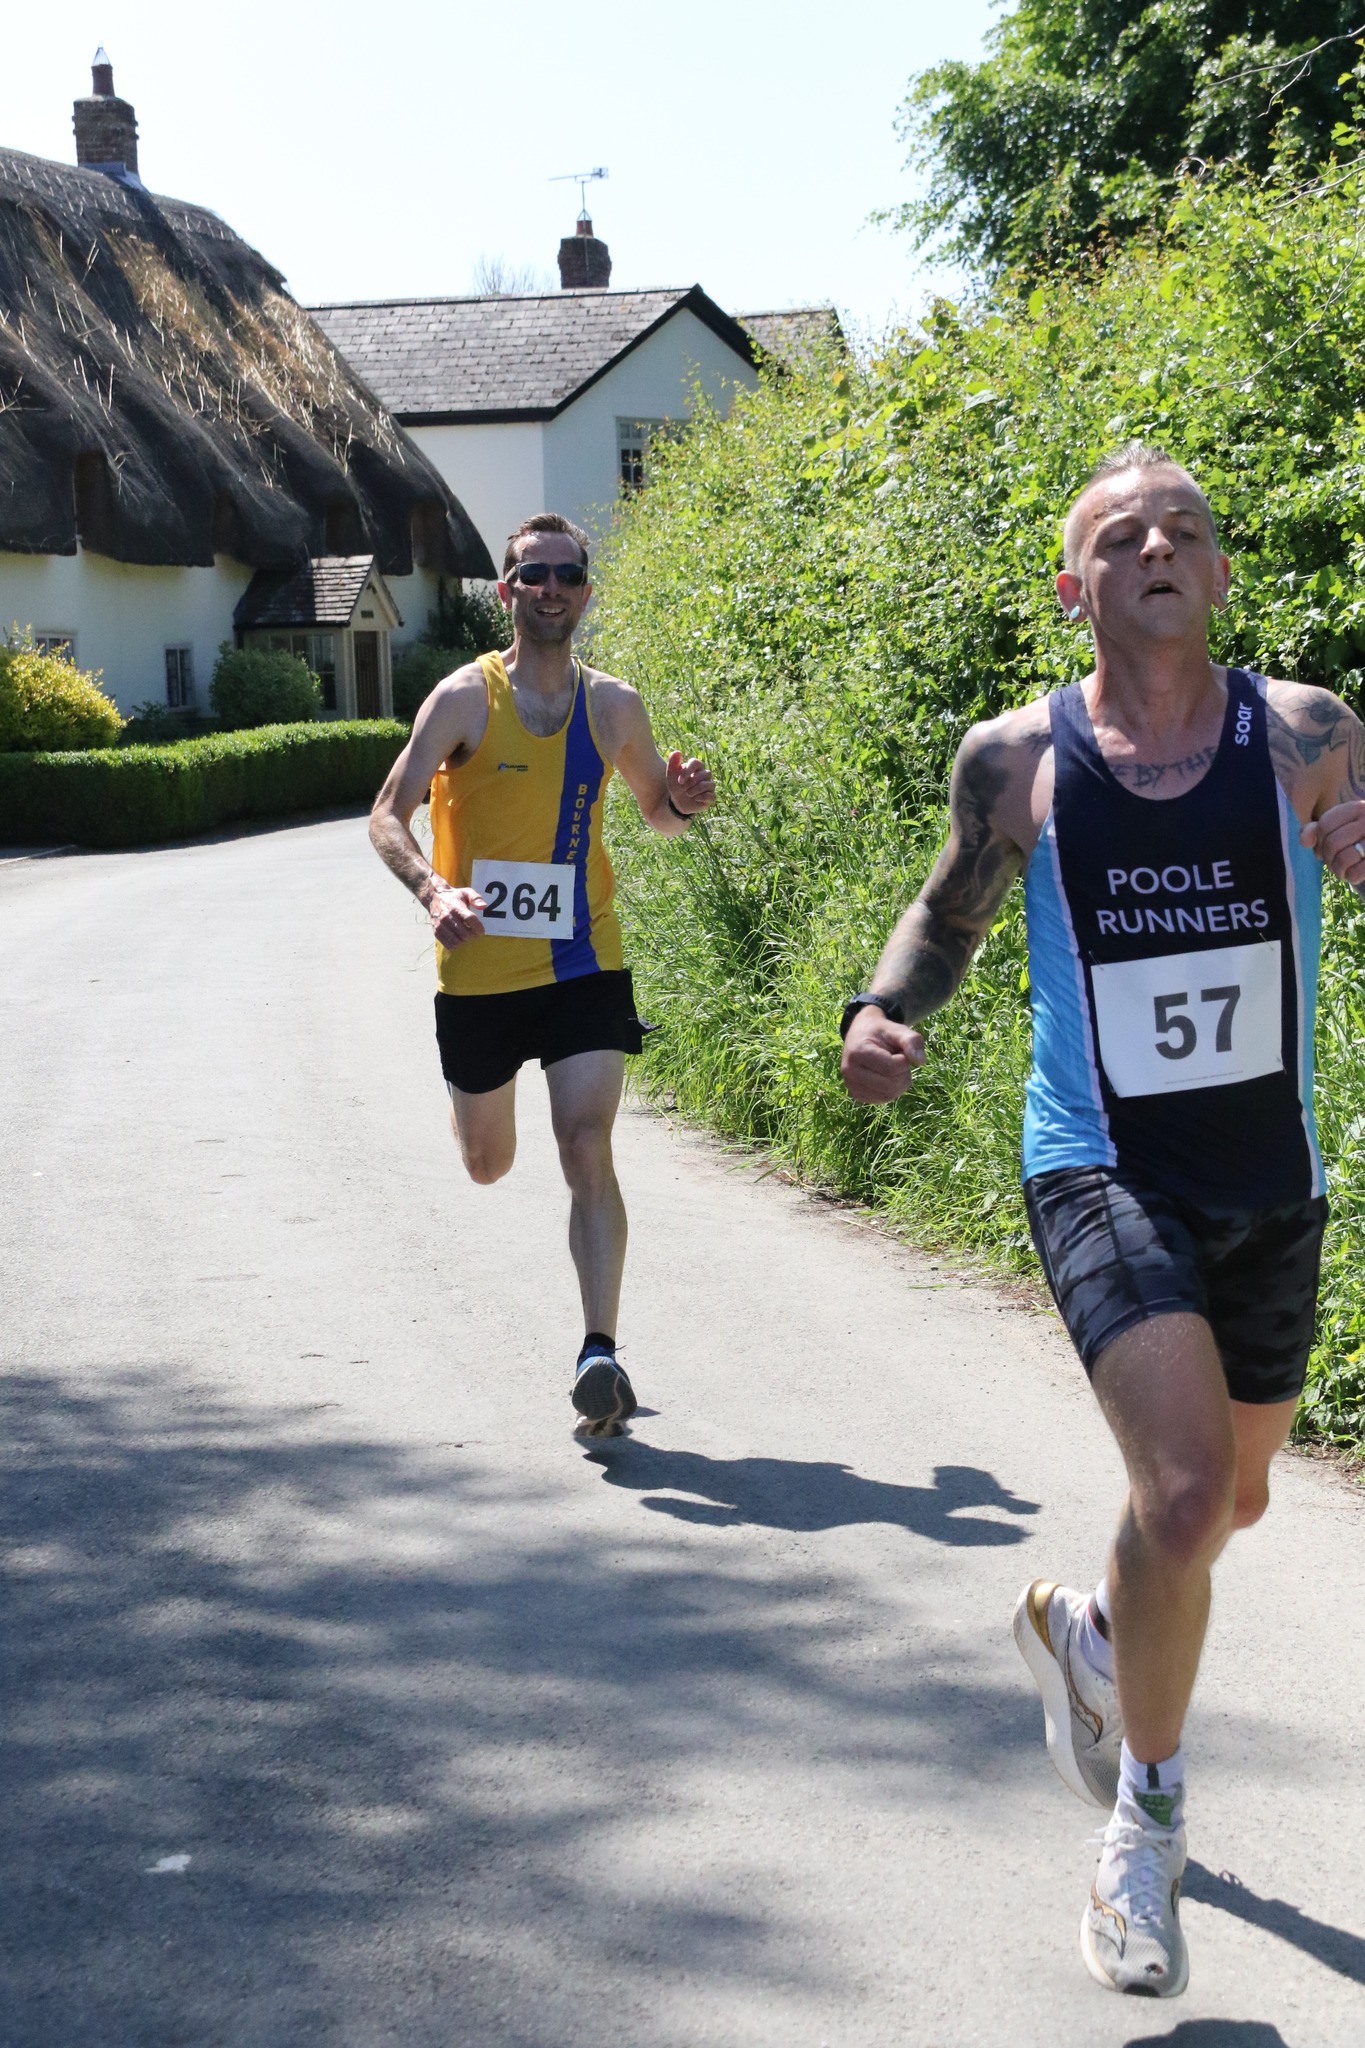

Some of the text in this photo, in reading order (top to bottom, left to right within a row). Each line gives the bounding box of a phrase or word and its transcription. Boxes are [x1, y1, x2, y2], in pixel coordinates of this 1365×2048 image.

[1235, 701, 1253, 746] soar
[564, 783, 588, 866] BOURNE
[1107, 859, 1235, 896] POOLE
[482, 880, 562, 923] 264
[1095, 898, 1270, 935] RUNNERS
[1153, 984, 1242, 1061] 57
